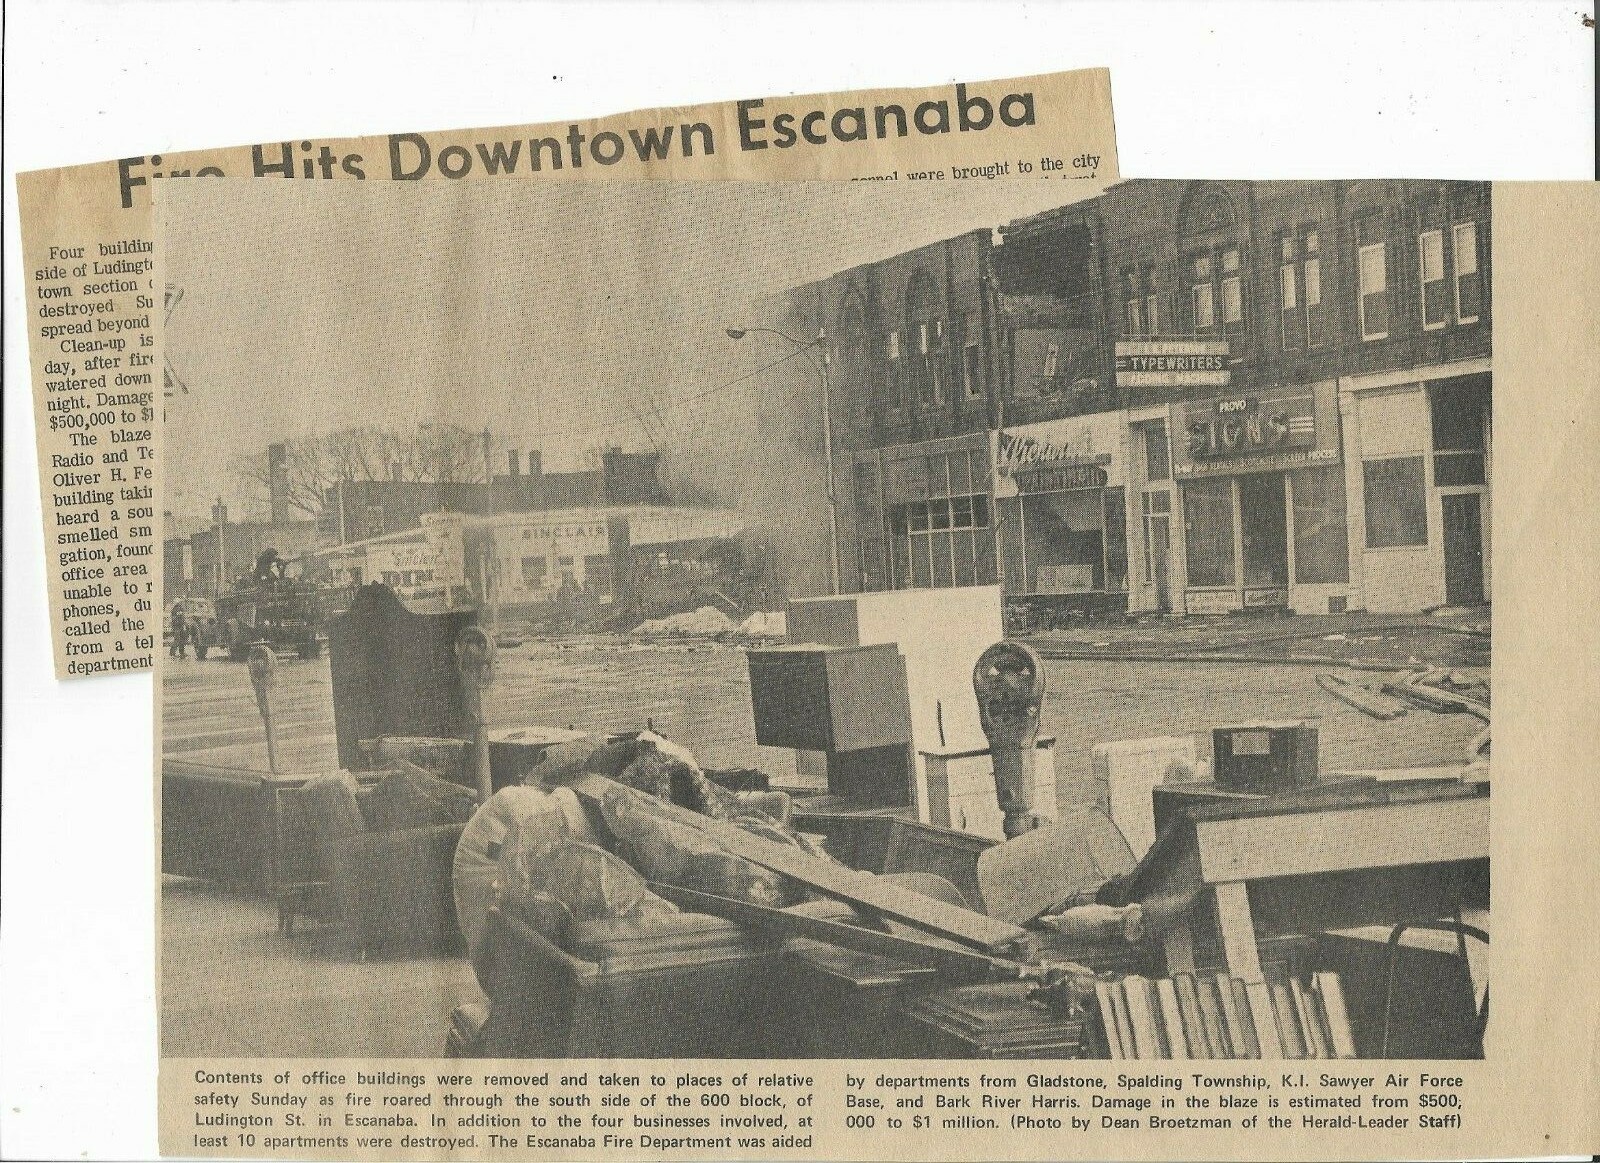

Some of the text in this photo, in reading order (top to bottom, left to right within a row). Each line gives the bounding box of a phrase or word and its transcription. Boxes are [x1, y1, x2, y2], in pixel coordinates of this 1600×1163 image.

[252, 140, 366, 180] Hits
[388, 122, 716, 180] Downtown
[736, 82, 1036, 152] Escanaba
[906, 170, 944, 180] were
[952, 160, 1009, 180] brought
[1017, 159, 1033, 174] to
[1040, 157, 1064, 171] the
[1072, 153, 1100, 170] city
[49, 239, 153, 260] Four buildin
[35, 257, 153, 281] side of Ludingt
[38, 285, 72, 299] town
[83, 279, 138, 296] section
[39, 295, 153, 318] destroyed Su
[41, 315, 149, 339] spread beyond
[60, 334, 154, 353] Clean-up is
[44, 360, 76, 376] day,
[84, 356, 121, 372] after
[1130, 356, 1222, 370] TYPEWRITERS
[46, 373, 152, 393] watered down
[47, 394, 91, 413] night.
[1219, 400, 1246, 412] PROVO
[50, 411, 116, 432] $500,000
[121, 410, 136, 424] to
[69, 429, 152, 446] The blaze
[1190, 410, 1288, 452] SIGNS
[52, 452, 94, 468] Radio
[102, 449, 128, 464] and
[53, 466, 152, 487] Oliver H. Fe
[52, 490, 114, 507] building
[56, 506, 153, 526] heard a sou
[57, 525, 152, 544] smelled sm
[59, 547, 112, 566] gation,
[61, 564, 148, 582] office area
[62, 584, 112, 600] unable
[123, 581, 138, 595] to
[62, 599, 152, 621] phones, du
[65, 618, 145, 636] called the
[65, 642, 104, 656] from
[115, 640, 124, 651] a
[67, 654, 154, 676] department
[194, 1070, 814, 1090] Contents of office buildings were removed and taken to places of relative
[846, 1073, 1464, 1091] by departments from Gladstone, Spalding Township, K.I. Sawyer Air Force
[194, 1091, 813, 1110] safety Sunday as fire roared through the south side of the 600 block, of
[846, 1094, 885, 1110] Base,
[896, 1094, 924, 1108] and
[936, 1094, 971, 1108] Bark
[982, 1094, 1022, 1109] River
[1032, 1094, 1081, 1109] Harris.
[1091, 1094, 1152, 1112] Damage
[1161, 1095, 1175, 1109] in
[1185, 1095, 1210, 1109] the
[1219, 1094, 1258, 1108] blaze
[1268, 1094, 1279, 1108] is
[1288, 1094, 1362, 1108] estimated
[1371, 1094, 1409, 1108] from
[195, 1112, 813, 1131] Ludington St. in Escanaba. In addition to the four businesses involved, at
[845, 1113, 1462, 1132] 000 to $1 million. (Photo by Dean Broetzman of the Herald-Leader Staff)
[194, 1132, 812, 1151] least 10 apartments were destroyed. The Escanaba Fire Department was aided
